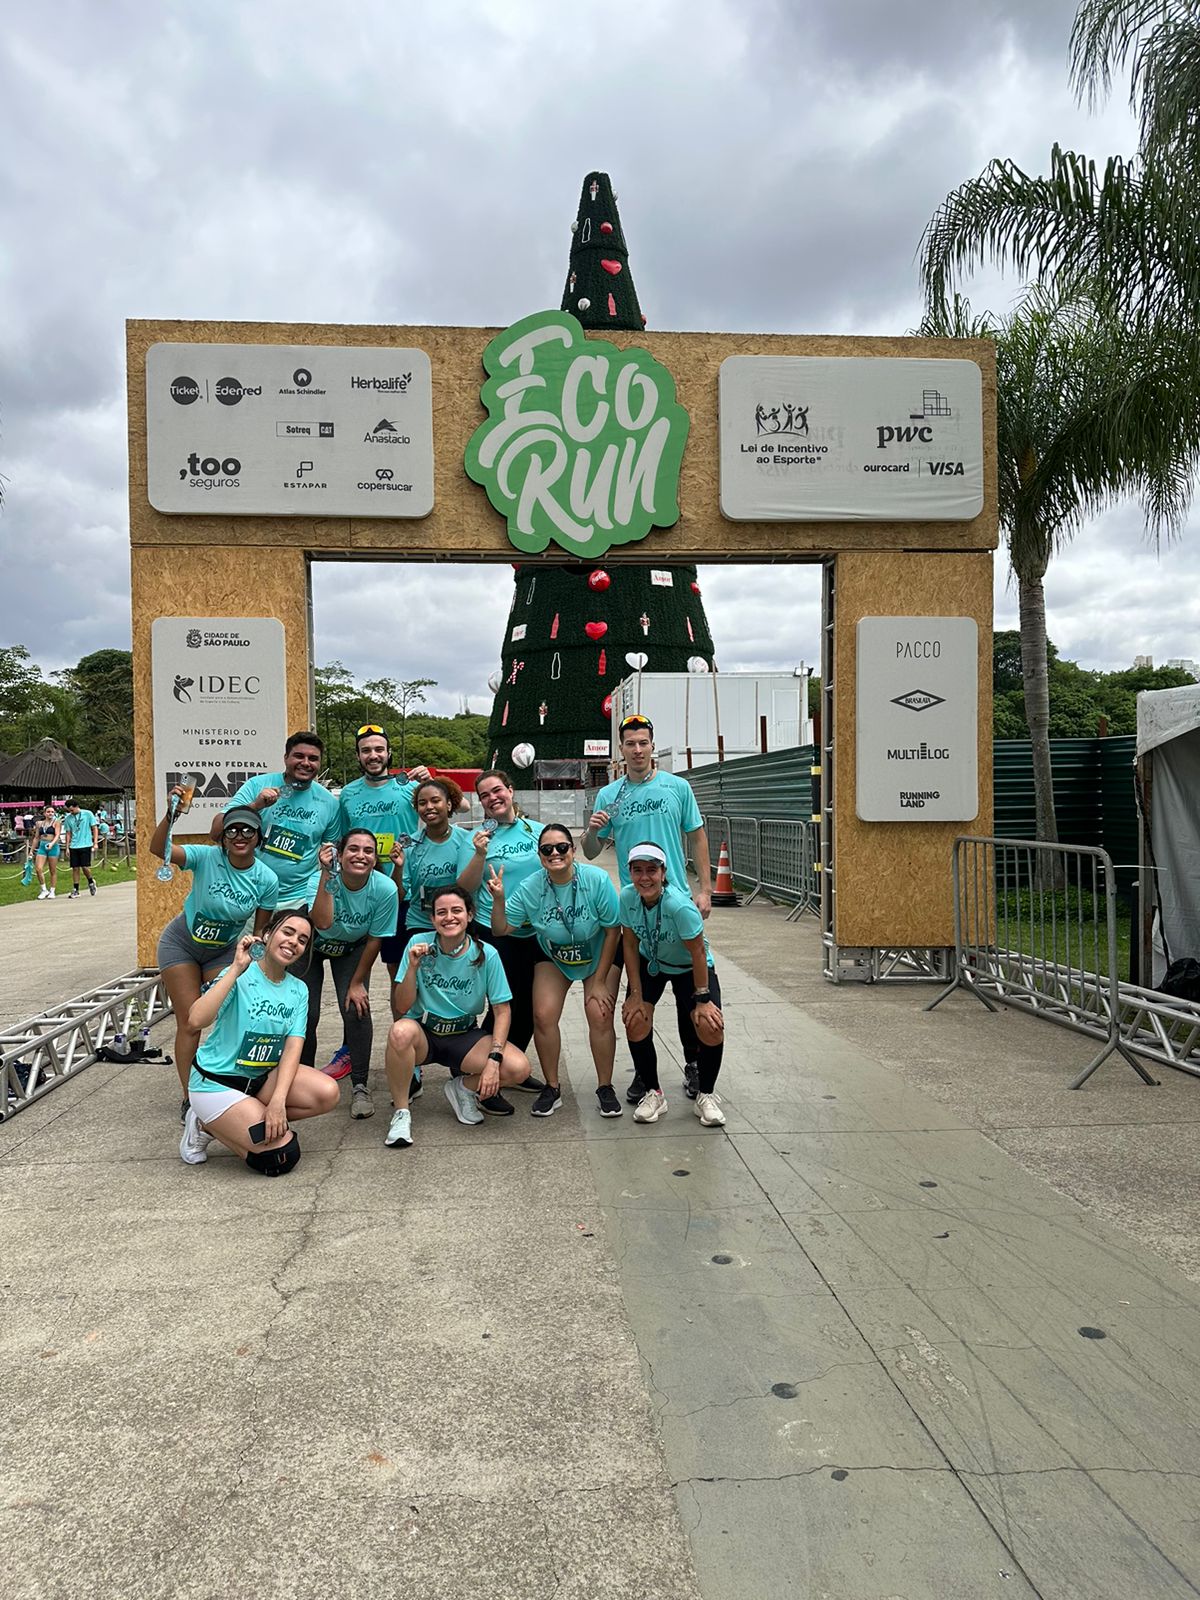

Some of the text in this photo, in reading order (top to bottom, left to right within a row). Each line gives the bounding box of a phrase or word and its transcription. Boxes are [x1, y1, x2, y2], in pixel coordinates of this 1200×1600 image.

[351, 376, 408, 390] Herbalife
[170, 385, 262, 397] Ticket Edenred
[297, 388, 327, 396] Schindler
[286, 425, 334, 435] Sotreq CAT
[876, 426, 933, 448] pwc
[740, 444, 829, 454] Lei de Incentivo
[756, 455, 816, 466] ao Esporte
[863, 462, 965, 476] ourocard VISA
[189, 478, 241, 490] seguros
[357, 482, 413, 492] copersucar
[203, 637, 250, 647] SÃO PAULO
[896, 641, 941, 658] PACCO
[199, 675, 260, 694] IDEC
[199, 738, 242, 746] ESPORTE
[900, 791, 940, 799] RUNNING
[900, 800, 925, 808] LAND
[273, 835, 296, 852] 4182
[195, 924, 220, 941] 4251
[320, 943, 345, 954] 4299
[556, 949, 582, 961] 4275
[433, 1023, 456, 1033] 4181
[247, 1044, 273, 1062] 4187
